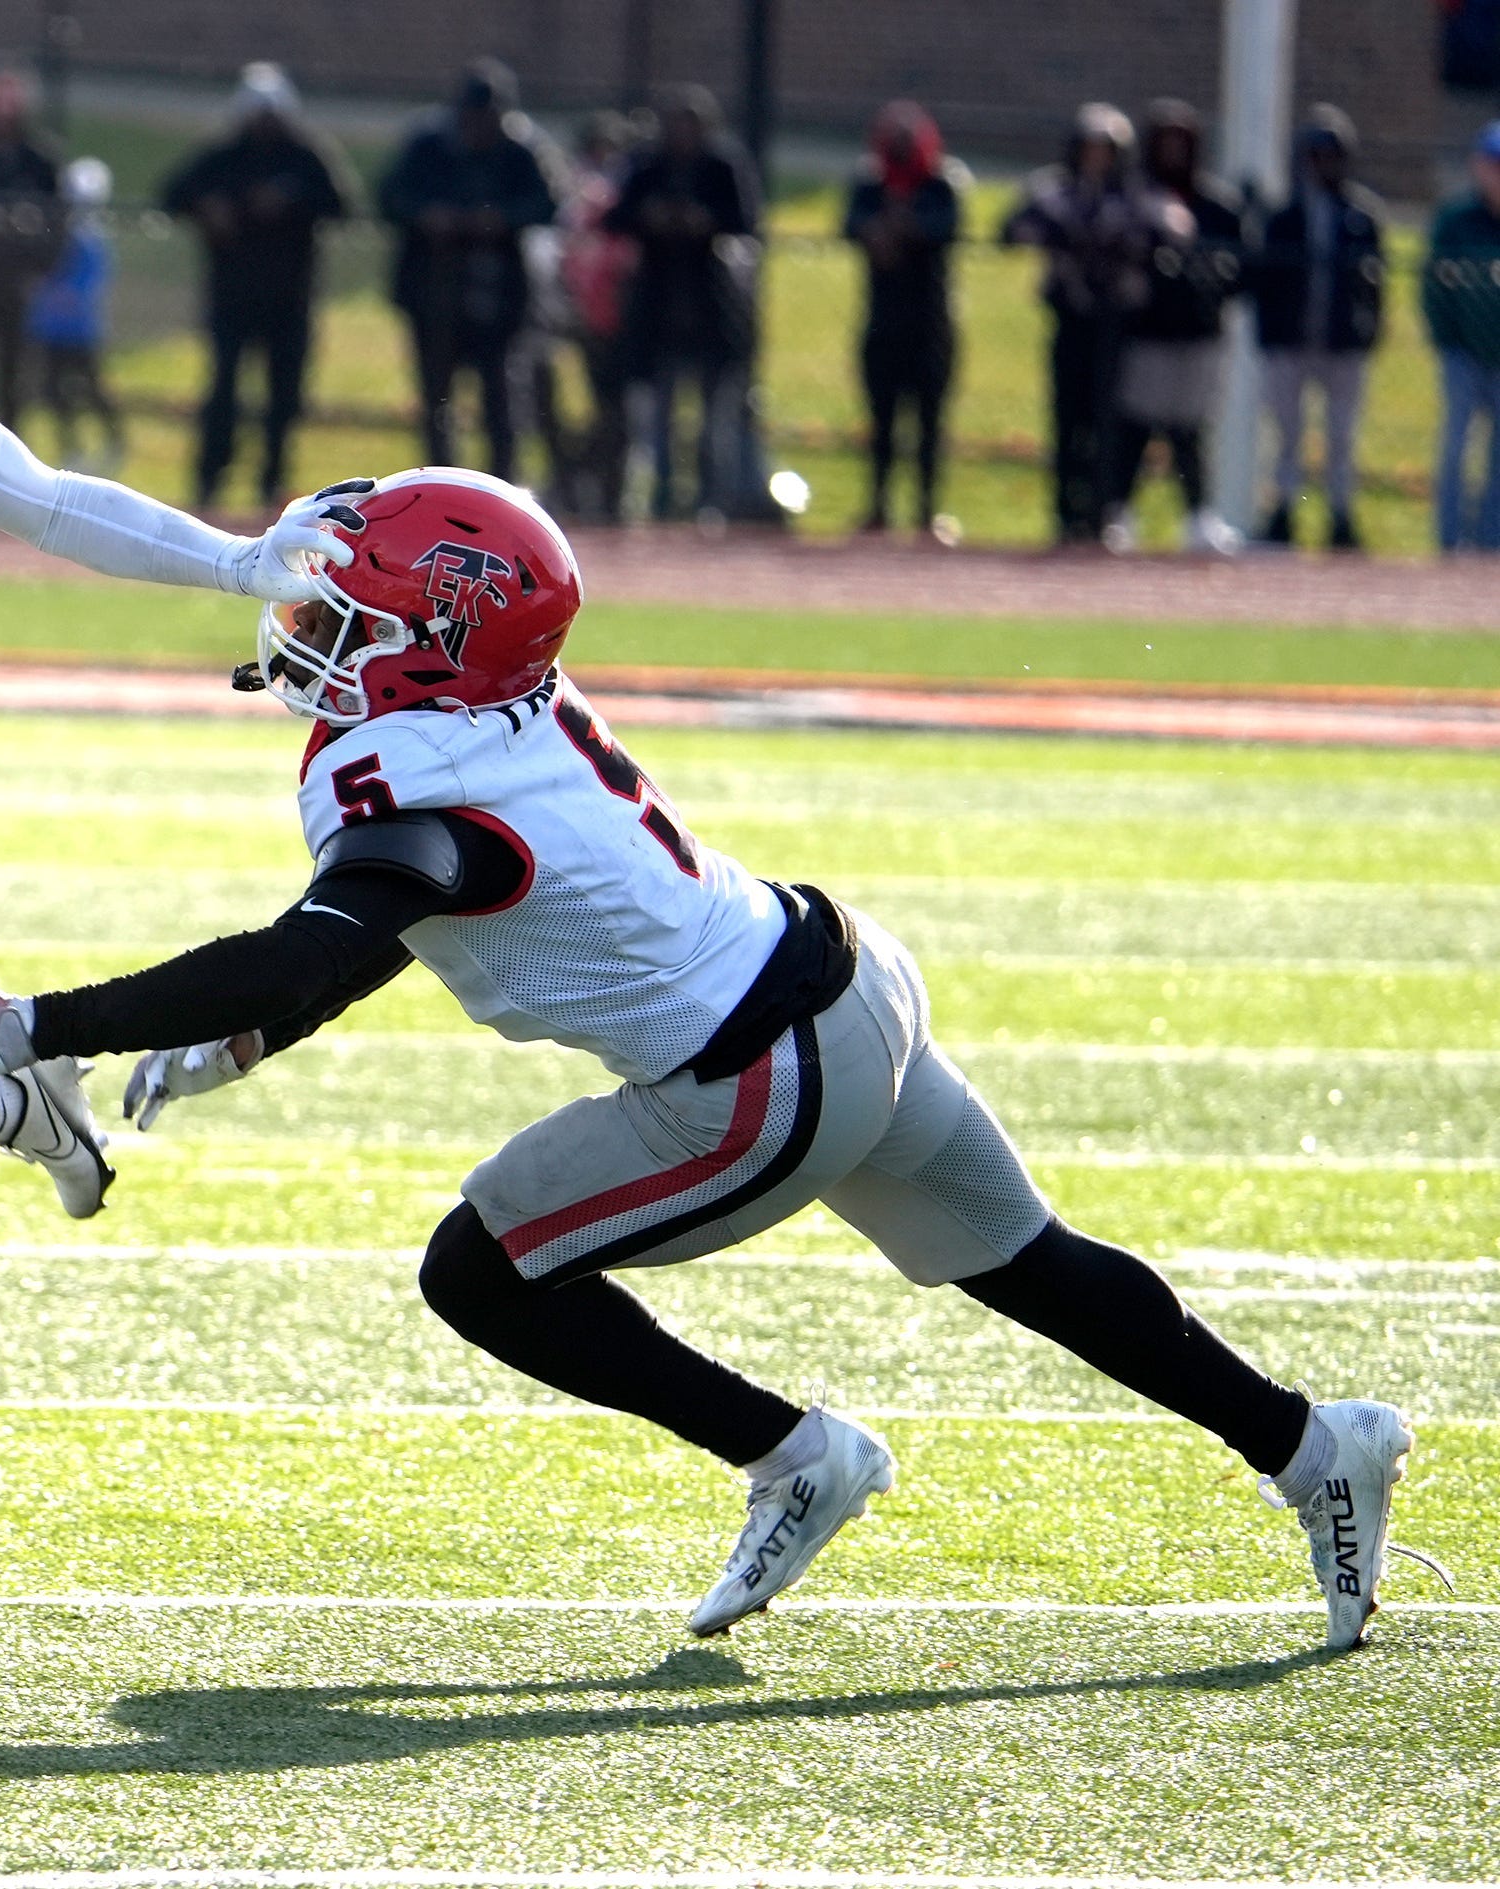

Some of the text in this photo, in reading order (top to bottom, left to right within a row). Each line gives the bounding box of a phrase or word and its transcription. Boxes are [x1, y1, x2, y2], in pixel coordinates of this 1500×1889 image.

[425, 550, 482, 627] EK
[331, 752, 398, 827] 5
[739, 1474, 817, 1592] BATTLE
[1325, 1478, 1361, 1597] BATTLE
